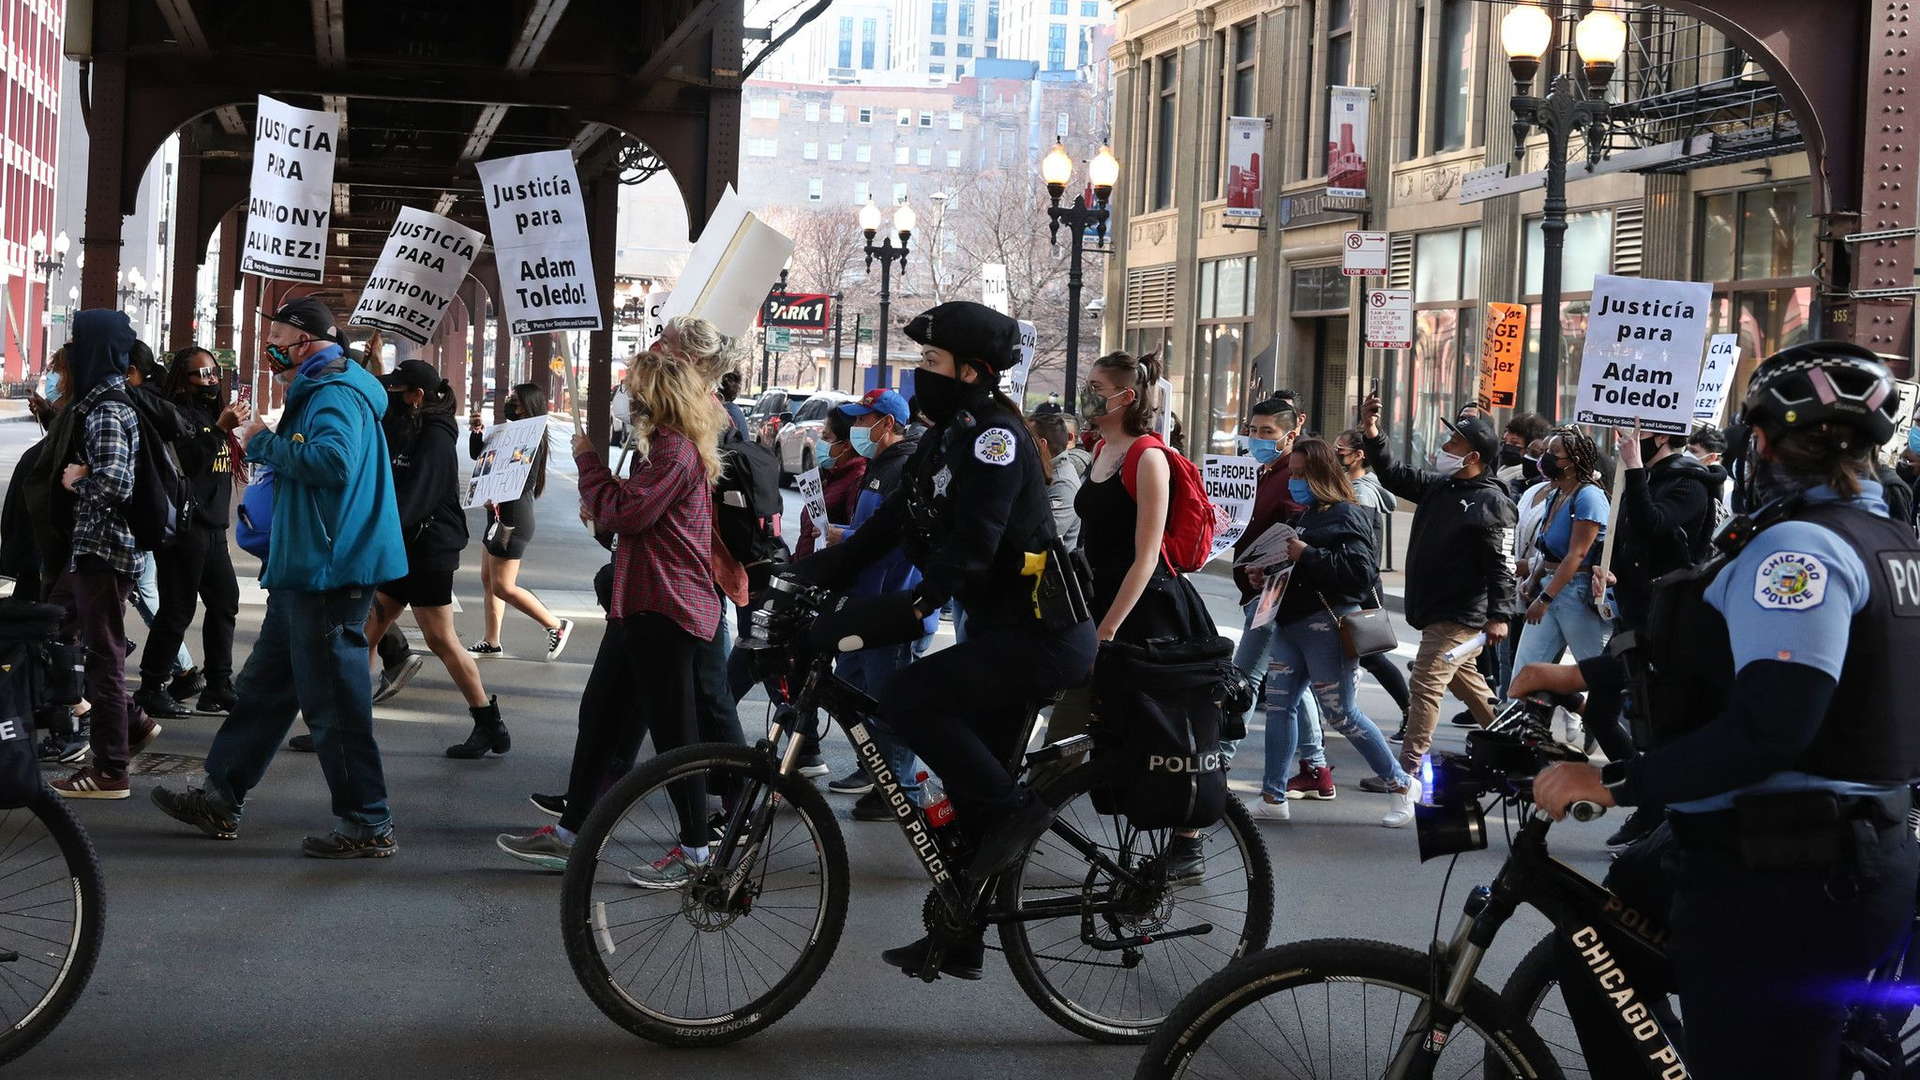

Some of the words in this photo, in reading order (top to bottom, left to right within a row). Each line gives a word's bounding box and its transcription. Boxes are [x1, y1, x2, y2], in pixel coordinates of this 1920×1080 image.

[493, 175, 571, 209] Justicía
[515, 208, 562, 234] para
[390, 221, 474, 261] JUSTICÍA
[396, 245, 445, 273] PARA
[520, 257, 576, 281] Adam
[367, 277, 449, 310] ANTHONY
[516, 283, 586, 308] Toledo!
[358, 298, 435, 331] ALVAREZ!
[770, 301, 812, 320] PARK
[814, 303, 823, 321] 1
[1598, 295, 1695, 319] Justicía
[1832, 309, 1848, 322] 355
[1617, 323, 1673, 342] para
[1603, 361, 1673, 385] Adam
[1591, 384, 1679, 410] Toledo!
[1580, 413, 1595, 422] PSL
[979, 429, 1012, 445] CHICAGO
[981, 449, 1011, 462] POLICE
[1207, 467, 1219, 478] THE
[1220, 464, 1255, 480] PEOPLE
[1206, 481, 1255, 500] DEMAND:
[1762, 554, 1820, 581] CHICAGO
[1761, 585, 1813, 605] POLICE
[1149, 752, 1220, 773] POLICE
[862, 742, 911, 818] CHICAGO
[906, 820, 949, 884] POLICE
[1603, 896, 1667, 945] POLI
[1572, 925, 1659, 1042] CHICAGO
[675, 1016, 751, 1037] BONTRAGER
